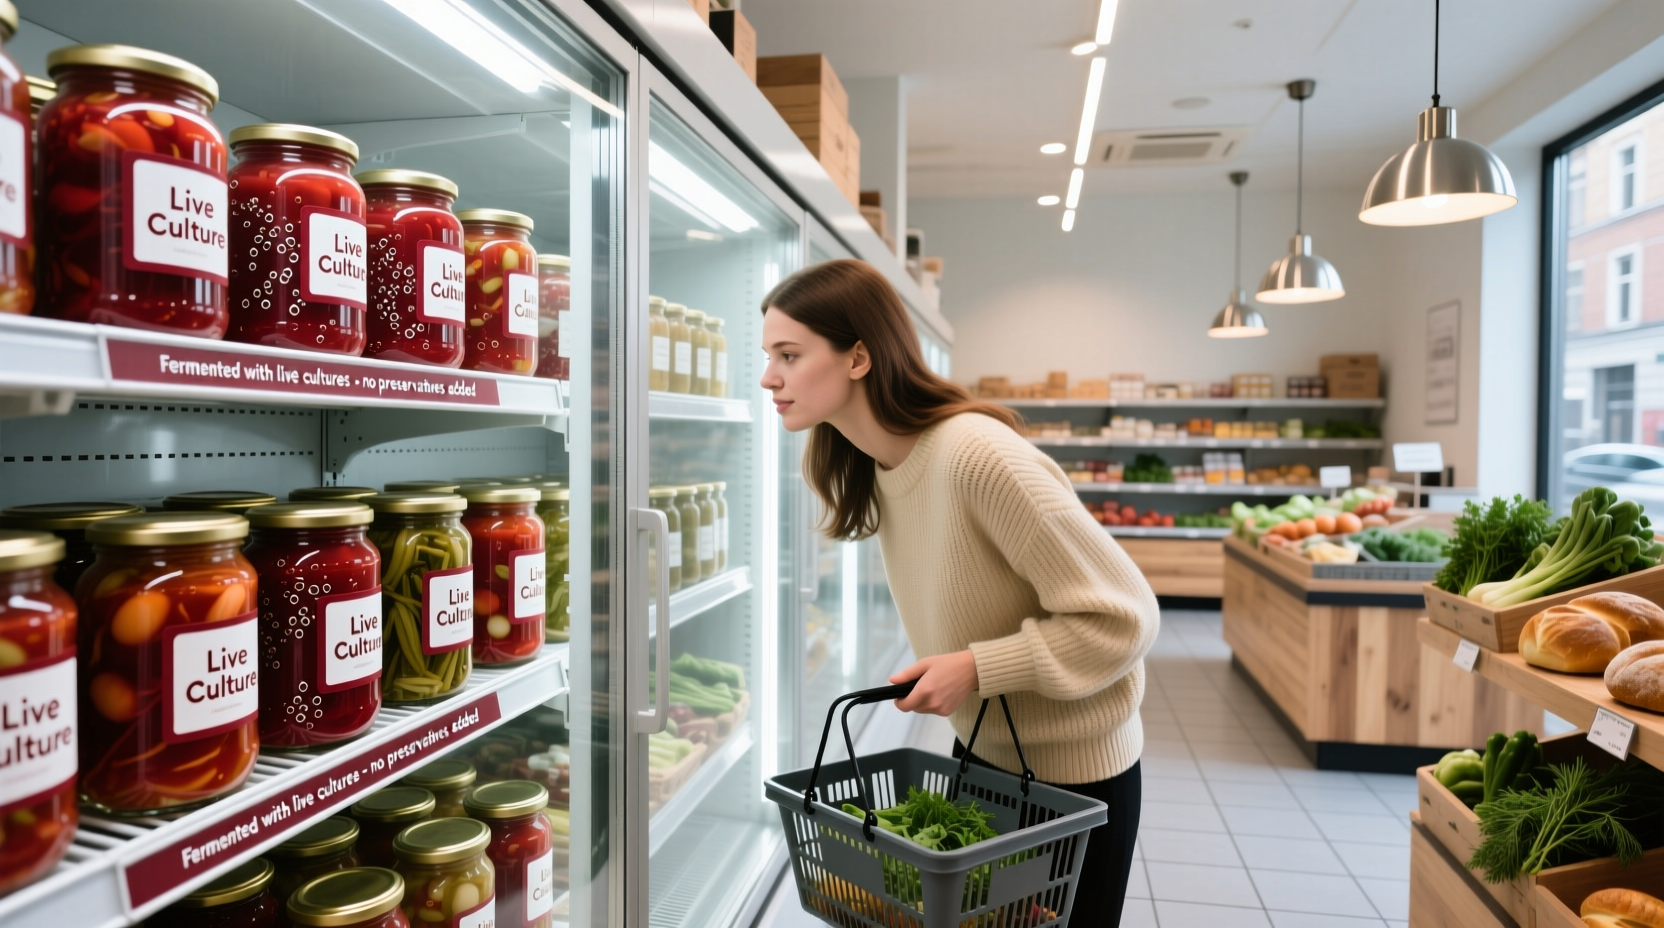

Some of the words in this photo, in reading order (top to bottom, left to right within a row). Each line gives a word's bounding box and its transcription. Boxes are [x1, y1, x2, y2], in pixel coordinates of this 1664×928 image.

[170, 186, 214, 218] Live
[147, 212, 226, 250] Culture
[334, 233, 362, 258] Live
[318, 254, 366, 281] Cultur
[159, 354, 241, 379] Fermented
[243, 363, 274, 382] with
[276, 364, 300, 384] live
[302, 367, 351, 387] cultures
[362, 376, 377, 389] no
[350, 613, 378, 636] Live
[207, 646, 248, 674] Live
[185, 669, 257, 704] Culture
[2, 696, 60, 732] Live
[0, 726, 72, 769] ulture
[181, 815, 259, 870] Fermented
[261, 801, 291, 828] with
[292, 793, 315, 813] live
[370, 757, 385, 775] no
